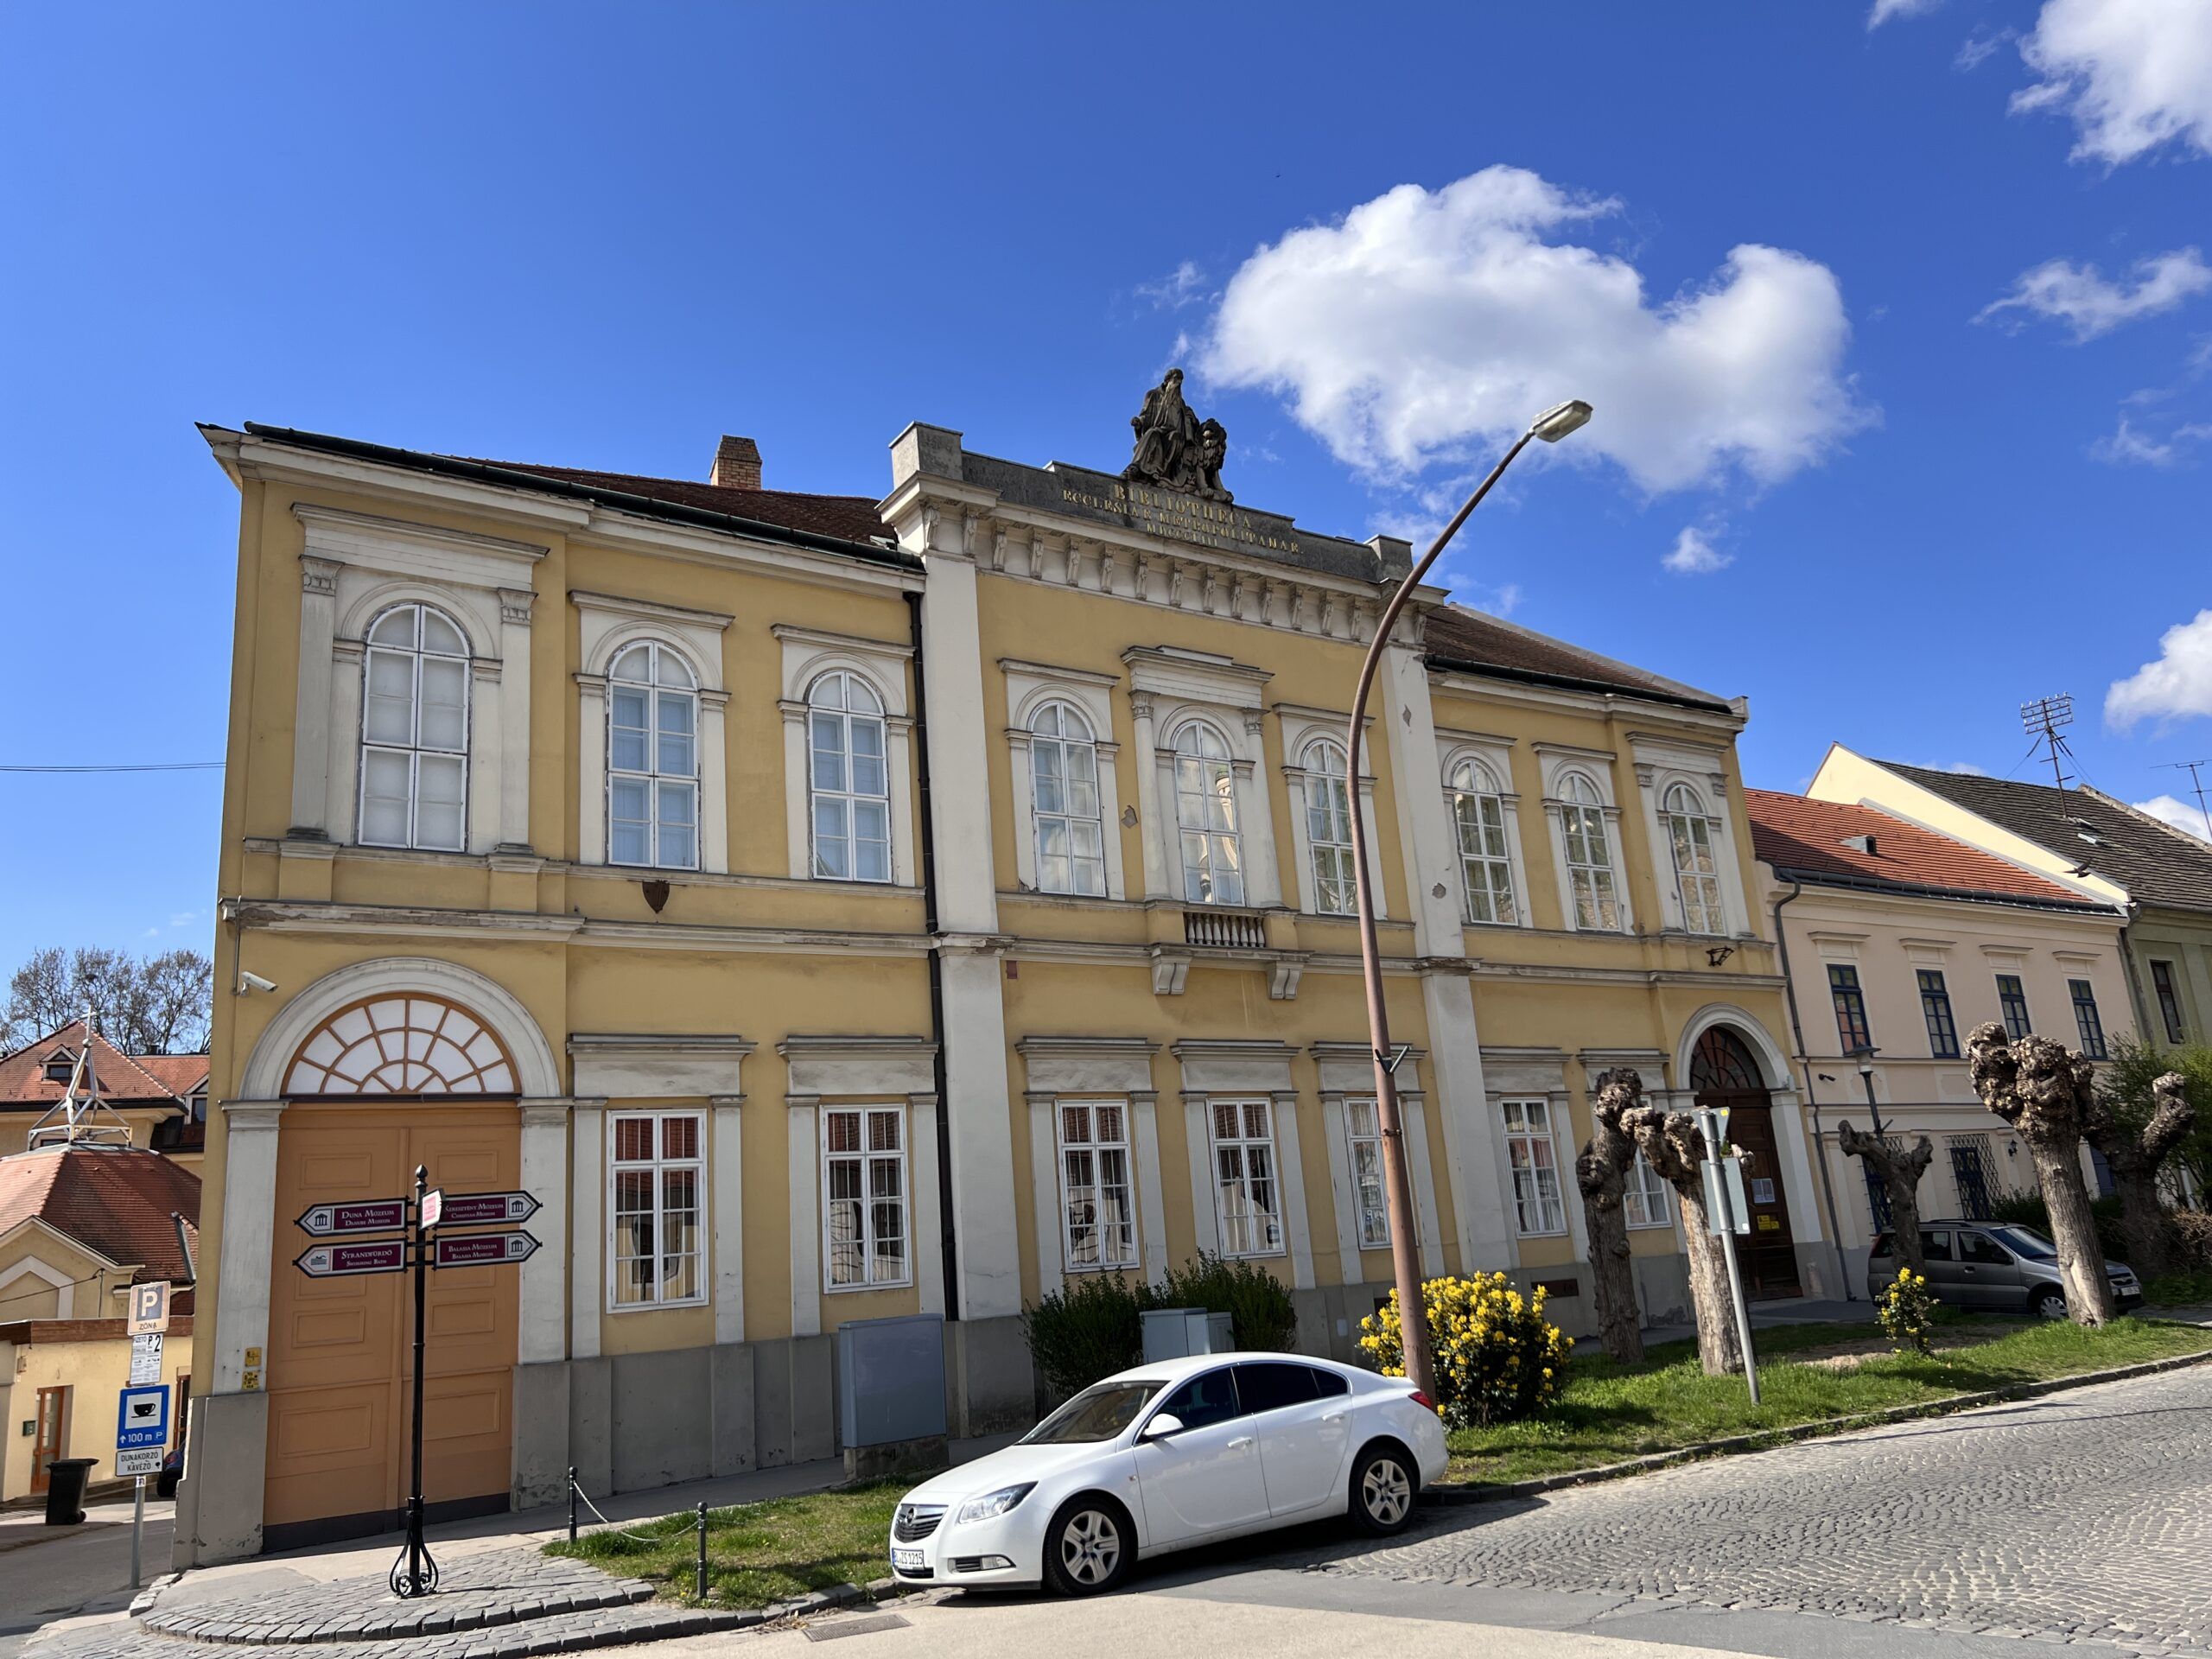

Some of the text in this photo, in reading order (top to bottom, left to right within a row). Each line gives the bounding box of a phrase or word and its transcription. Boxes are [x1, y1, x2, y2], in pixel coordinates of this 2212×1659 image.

[1062, 489, 1152, 520] ECCLESIAE
[1113, 484, 1252, 529] BIBLIOTHECA
[141, 1290, 158, 1317] P
[148, 1335, 153, 1345] P
[154, 1334, 161, 1352] 2
[128, 1433, 143, 1442] 100
